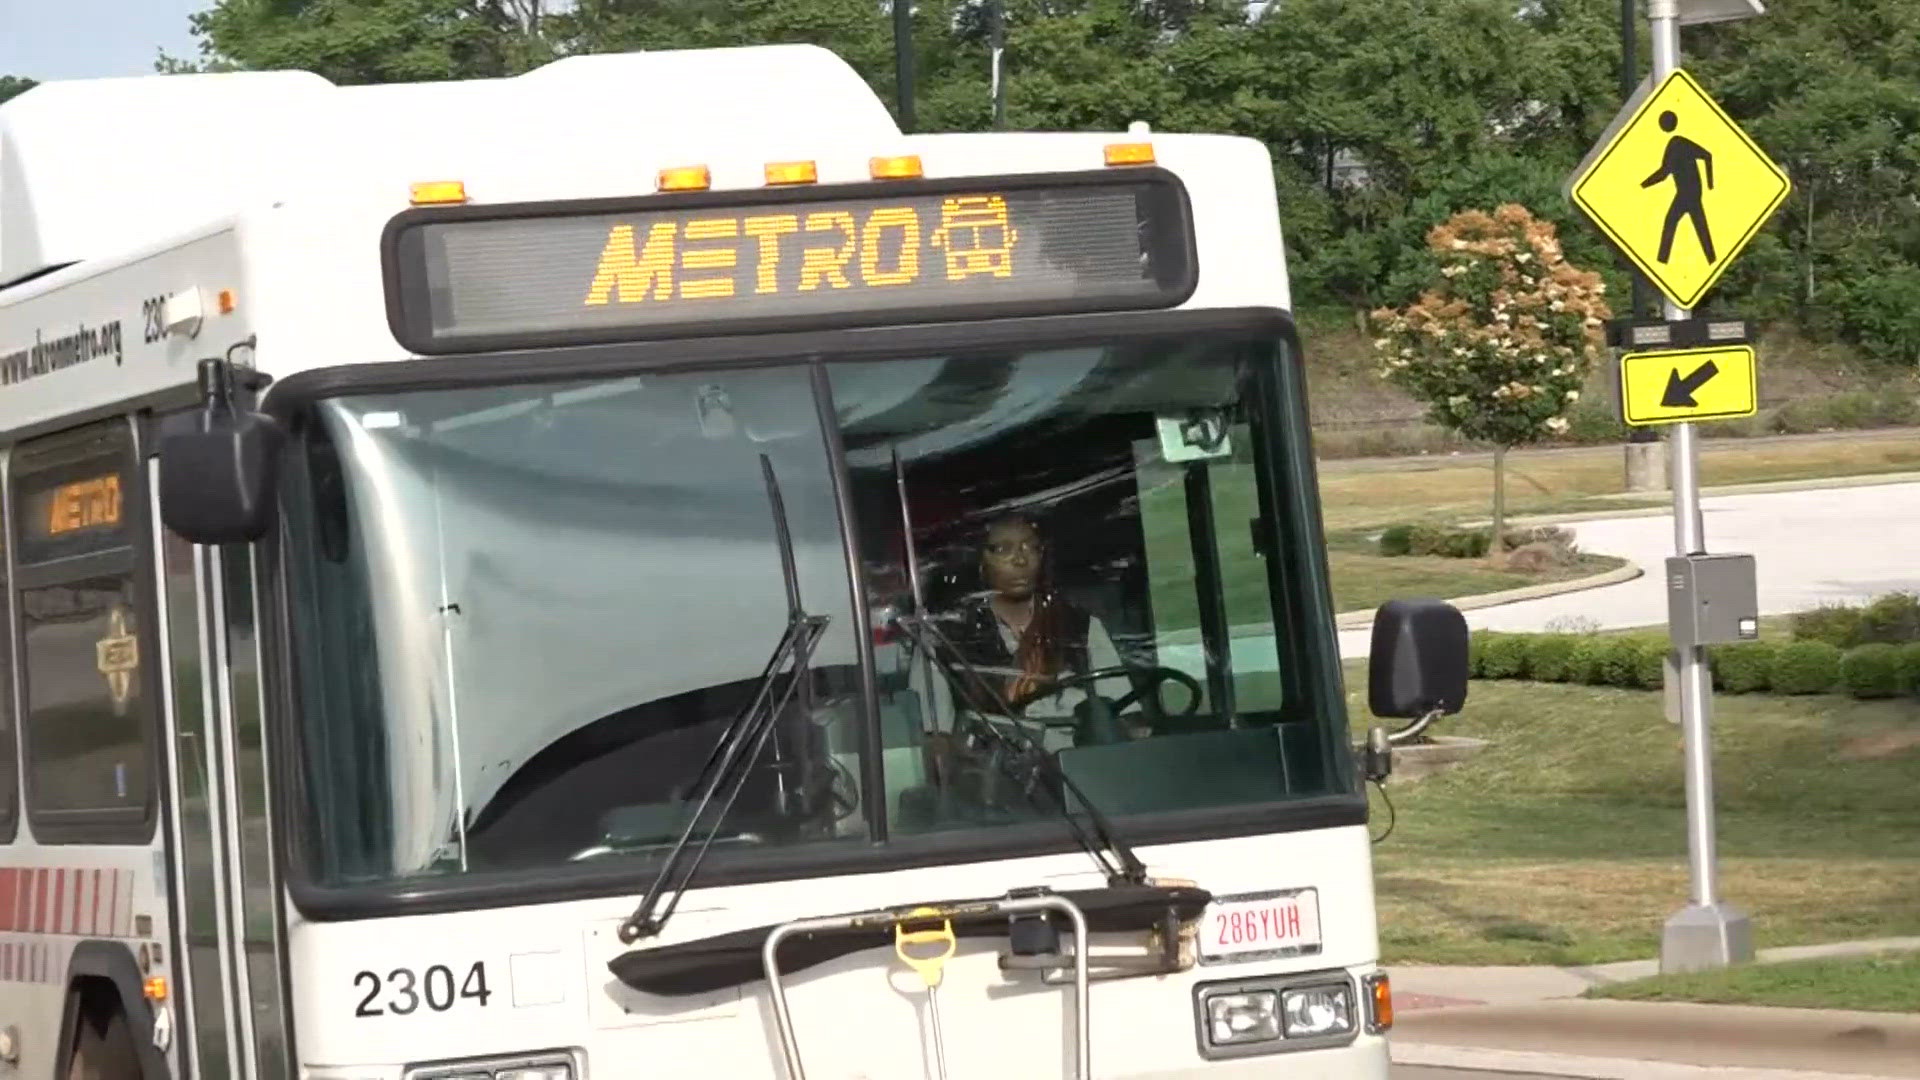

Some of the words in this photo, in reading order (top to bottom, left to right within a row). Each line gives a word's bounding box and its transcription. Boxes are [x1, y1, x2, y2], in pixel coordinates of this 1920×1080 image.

[584, 206, 920, 305] METRO
[48, 472, 121, 535] METRO
[1217, 904, 1300, 945] 286YUH
[353, 960, 492, 1018] 2304
